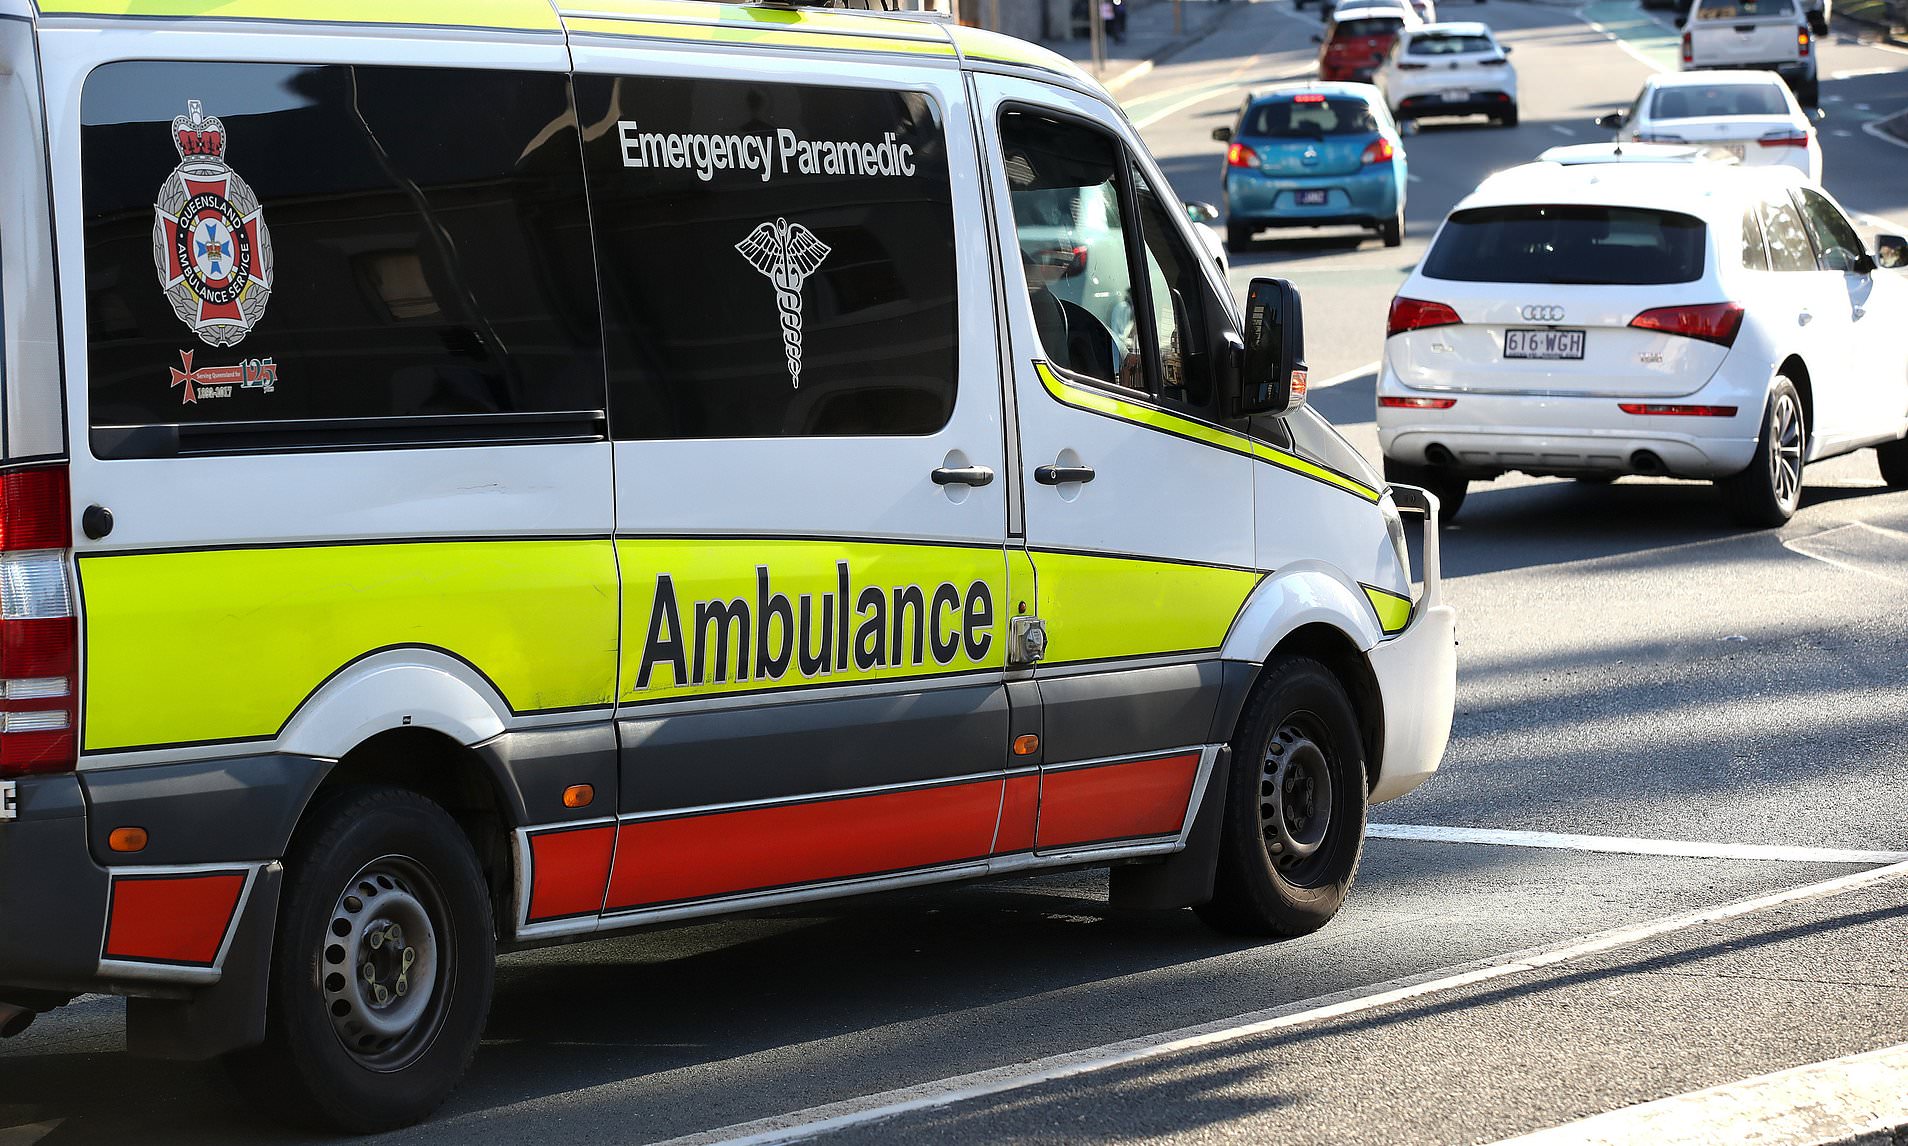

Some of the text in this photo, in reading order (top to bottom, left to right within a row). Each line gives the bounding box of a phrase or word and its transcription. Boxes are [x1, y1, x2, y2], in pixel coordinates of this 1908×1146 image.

[617, 120, 916, 182] Emergency Paramedic
[179, 195, 242, 230] QUEENSLAND
[177, 242, 250, 304] AMBULANCE SERVICE
[240, 358, 274, 388] 125
[634, 559, 994, 692] Ambulance
